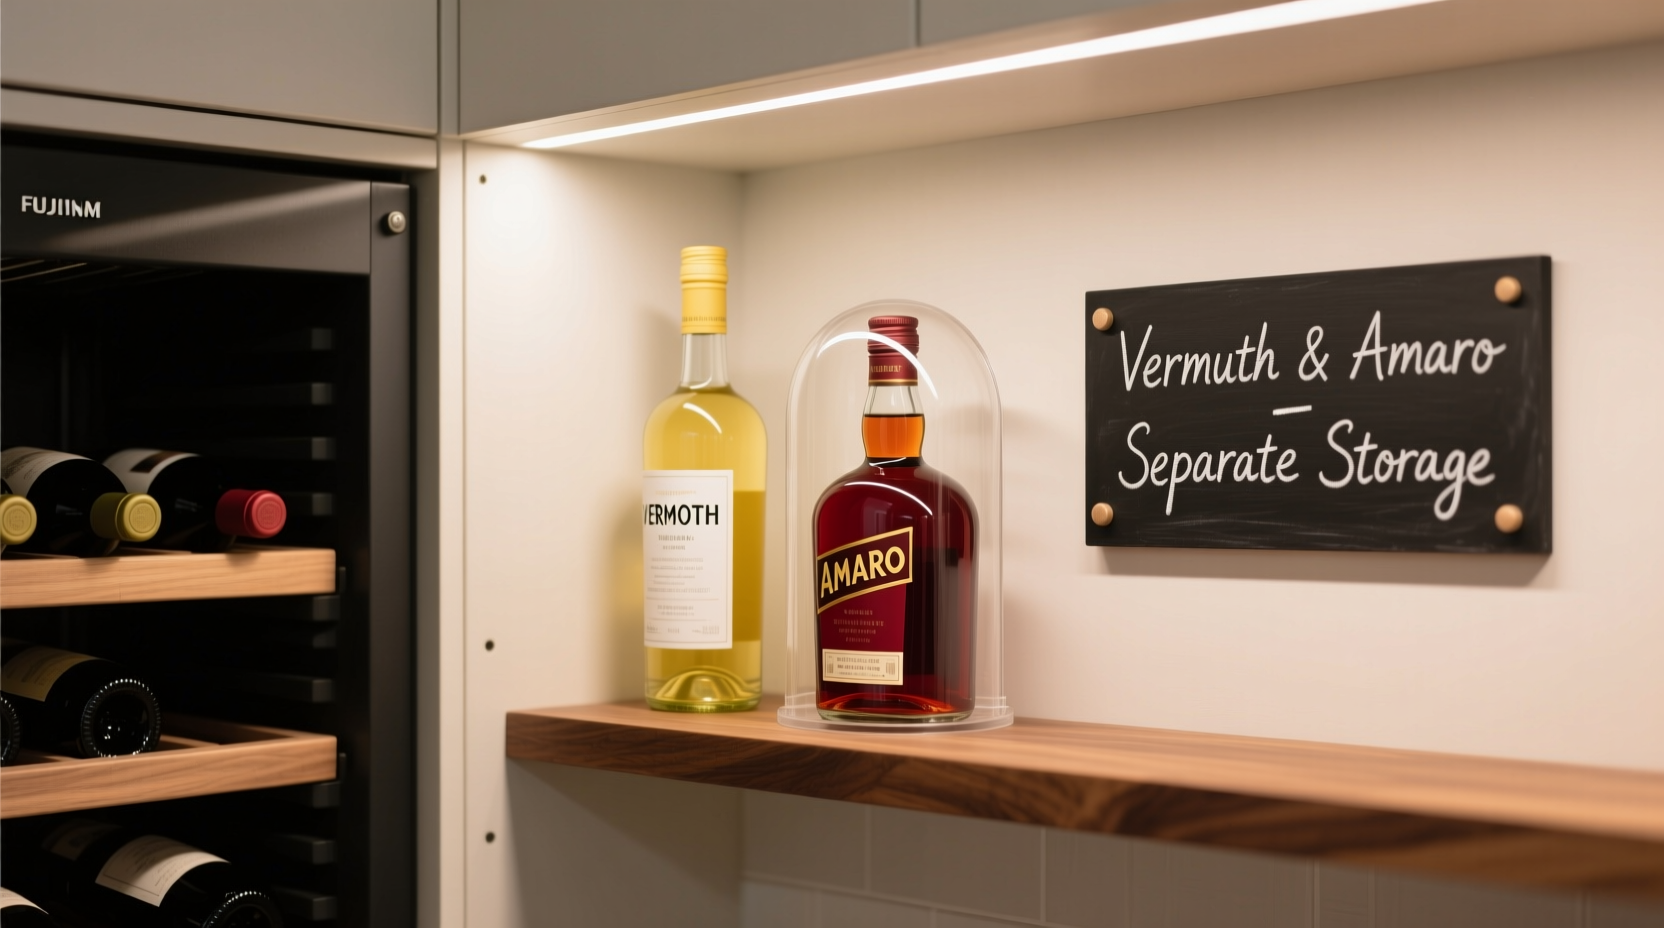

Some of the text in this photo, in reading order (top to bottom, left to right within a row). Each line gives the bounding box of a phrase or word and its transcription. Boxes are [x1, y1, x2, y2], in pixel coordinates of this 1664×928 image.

[1120, 310, 1507, 391] Vermuth & Amaro
[1118, 419, 1496, 521] Separate Storage
[820, 546, 906, 599] AMARO
